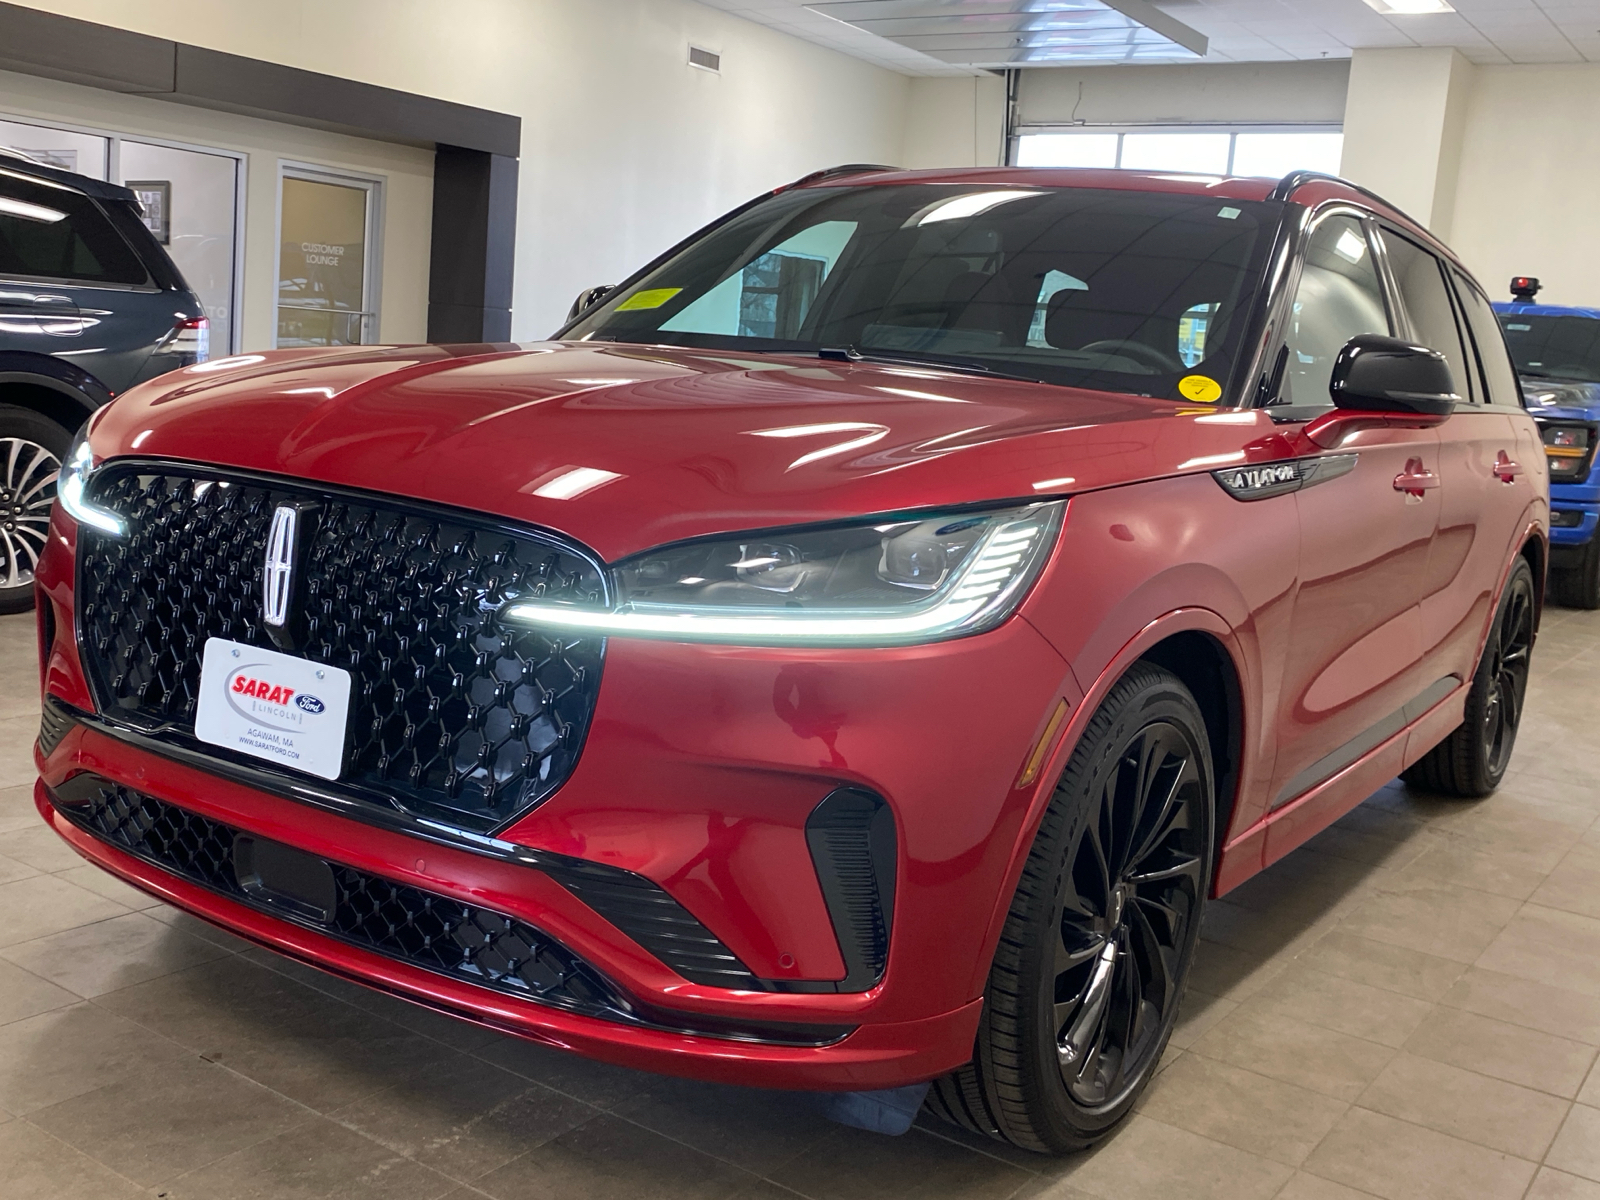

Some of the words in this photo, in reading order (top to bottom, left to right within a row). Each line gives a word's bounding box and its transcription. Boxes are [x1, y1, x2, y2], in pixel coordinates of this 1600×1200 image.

[302, 243, 344, 255] CUSTOMER
[306, 254, 339, 266] LOUNGE
[1232, 465, 1294, 488] AVIATOR
[232, 675, 294, 706] SARAT
[298, 695, 321, 713] Ford
[258, 704, 297, 721] LINCOLN
[238, 736, 300, 760] WWW.SARATFORD.COM
[247, 728, 281, 745] AGAWAM,
[282, 737, 294, 748] MA
